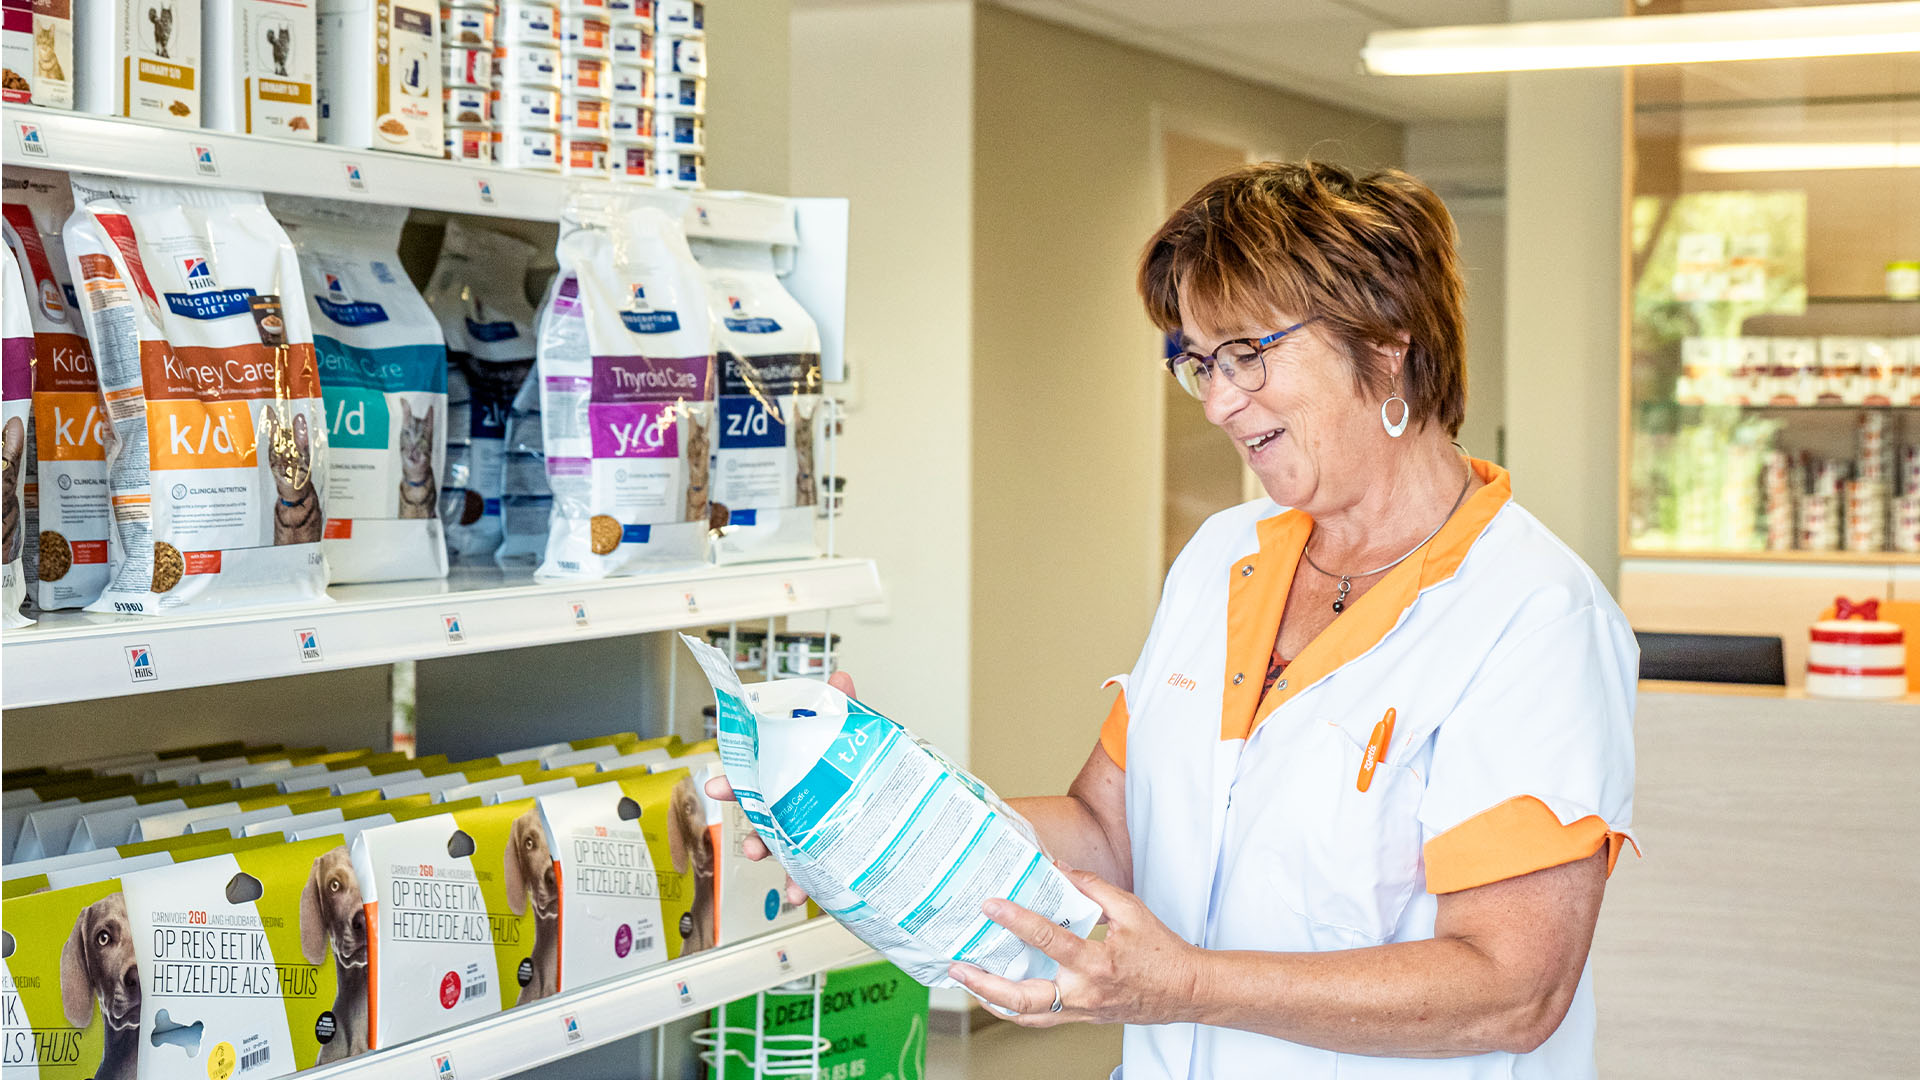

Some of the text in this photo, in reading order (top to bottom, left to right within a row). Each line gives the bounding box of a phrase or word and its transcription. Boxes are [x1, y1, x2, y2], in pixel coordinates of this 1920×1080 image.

[170, 292, 250, 307] PRESCRIPTION
[197, 304, 226, 316] DIET
[224, 360, 275, 383] Care
[610, 366, 697, 393] Thyroid Care
[325, 400, 366, 436] /d
[726, 404, 768, 437] z/d
[169, 413, 235, 455] k/d
[609, 413, 665, 457] y/d
[218, 486, 247, 494] NUTRITION
[114, 602, 144, 612] 9186U
[1167, 672, 1197, 691] Ellen
[838, 728, 869, 763] t/d
[1363, 744, 1377, 772] zoetis
[776, 801, 794, 822] ental
[791, 789, 810, 806] Care
[591, 841, 616, 866] REIS
[617, 843, 635, 868] EET
[419, 864, 434, 877] 2GO
[392, 880, 480, 911] OP REIS EET IK
[151, 911, 187, 924] CARNIVOER
[187, 910, 207, 925] 2GO
[258, 916, 284, 929] VOEDING
[392, 911, 521, 944] HETZELFDE ALS THUIS
[153, 928, 266, 961] OP REIS EET IK
[11, 976, 41, 989] VOEDING
[152, 964, 319, 996] HETZELFDE ALS THUIS
[2, 995, 20, 1026] IK
[822, 989, 857, 1015] BOX
[3, 1031, 83, 1064] LS THUIS
